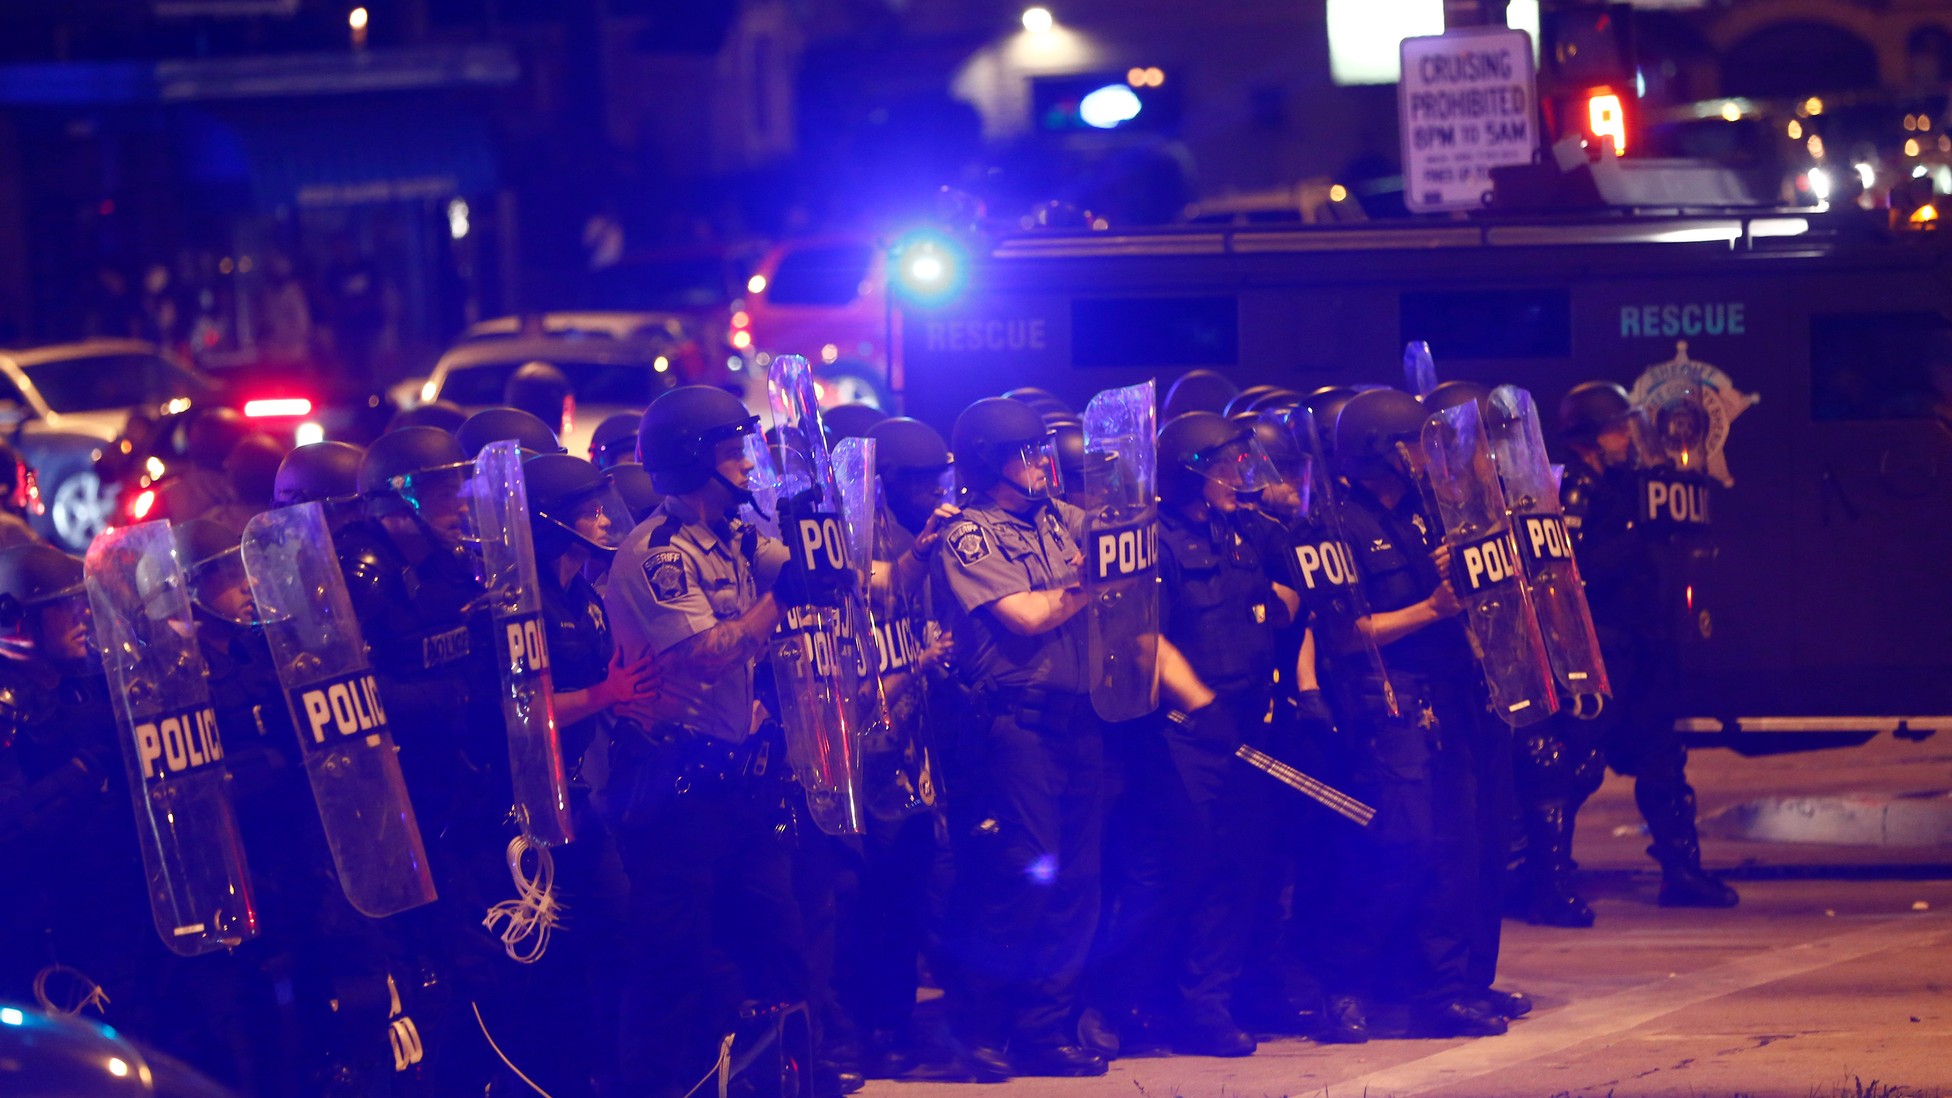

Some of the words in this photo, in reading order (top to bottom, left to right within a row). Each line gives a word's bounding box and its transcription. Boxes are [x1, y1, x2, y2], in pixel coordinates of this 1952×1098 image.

[1419, 51, 1513, 85] CRUISING
[1410, 85, 1526, 120] PROHIBITED
[1413, 126, 1455, 149] 8PM
[1462, 125, 1480, 145] TO
[1485, 120, 1526, 144] 5AM
[926, 319, 1046, 352] RESCUE
[1620, 303, 1746, 337] RESCUE
